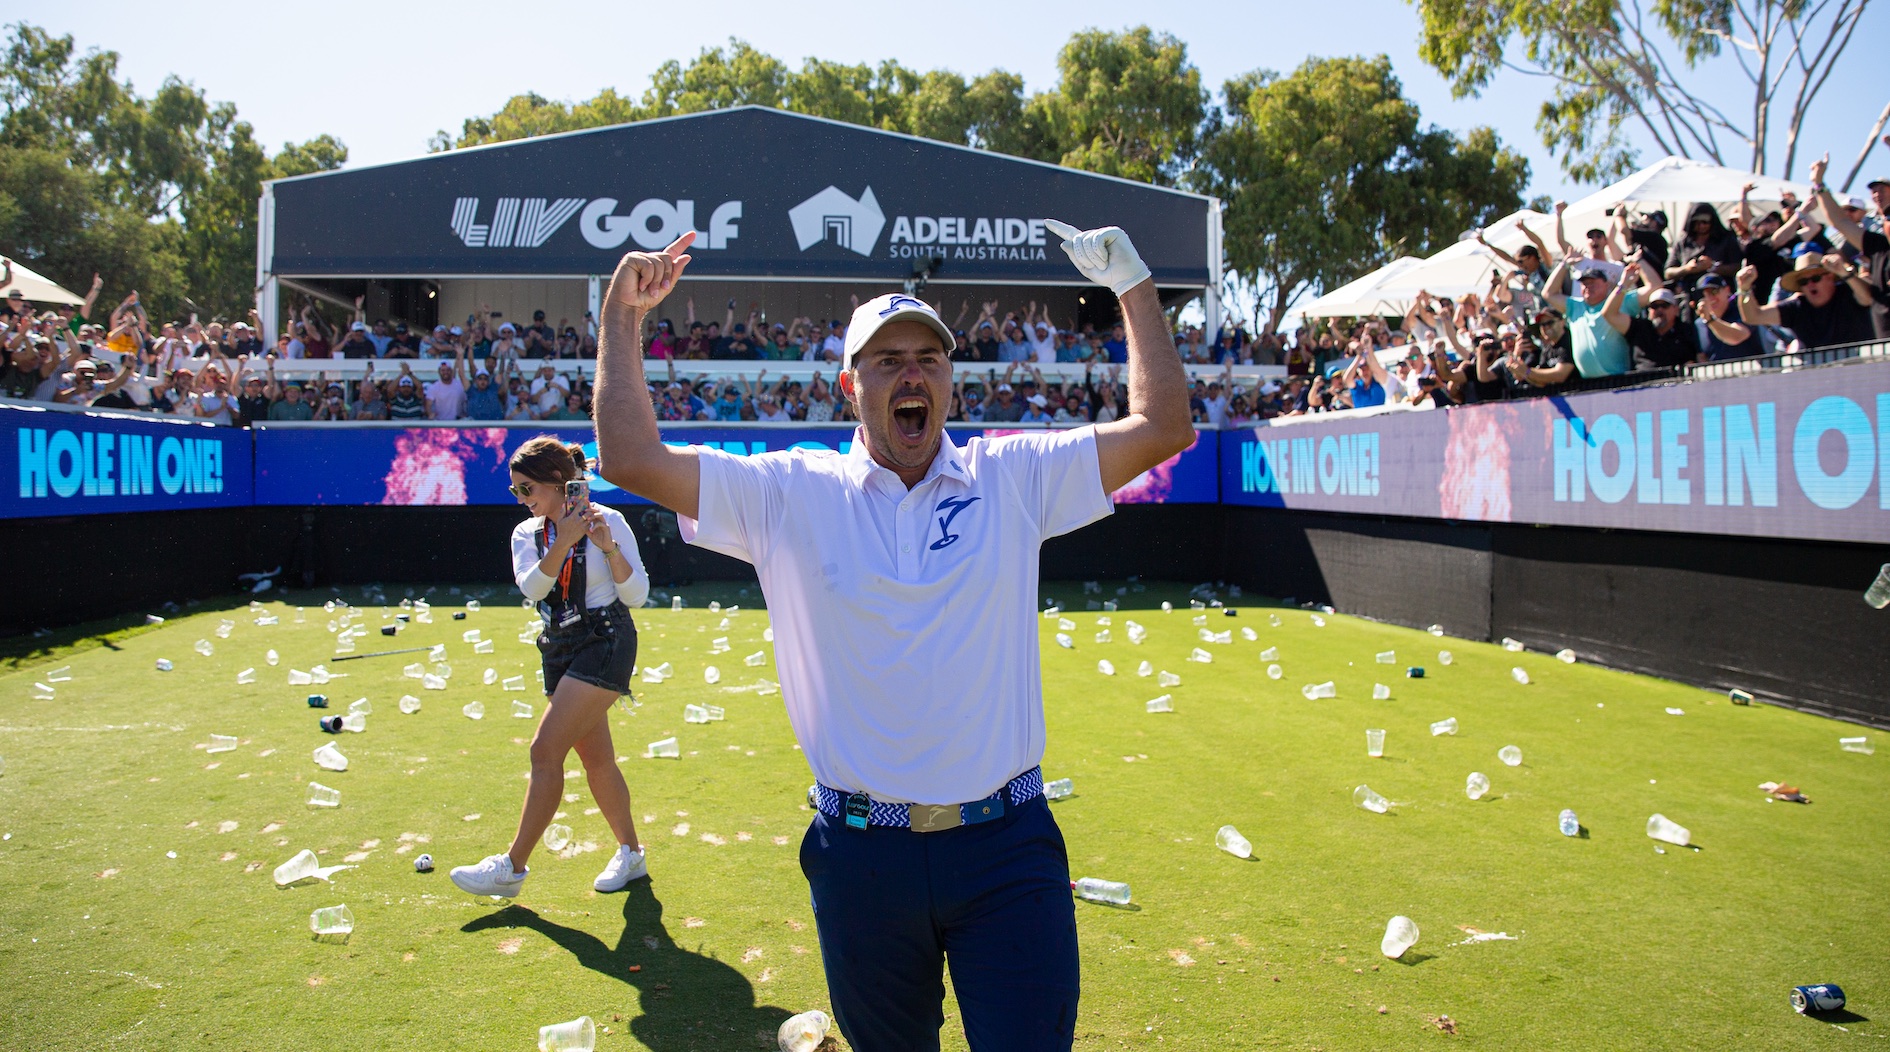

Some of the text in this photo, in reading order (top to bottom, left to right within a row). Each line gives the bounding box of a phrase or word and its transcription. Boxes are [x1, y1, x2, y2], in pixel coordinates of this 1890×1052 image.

[450, 197, 742, 249] LIV GOLF
[889, 216, 1047, 246] ADELAIDE
[889, 244, 1047, 261] SOUTH AUSTRALIA
[18, 427, 224, 498] HOLE IN ONE!
[1241, 431, 1380, 497] HOLE IN ONE!
[1552, 392, 1890, 511] HOLE IN O
